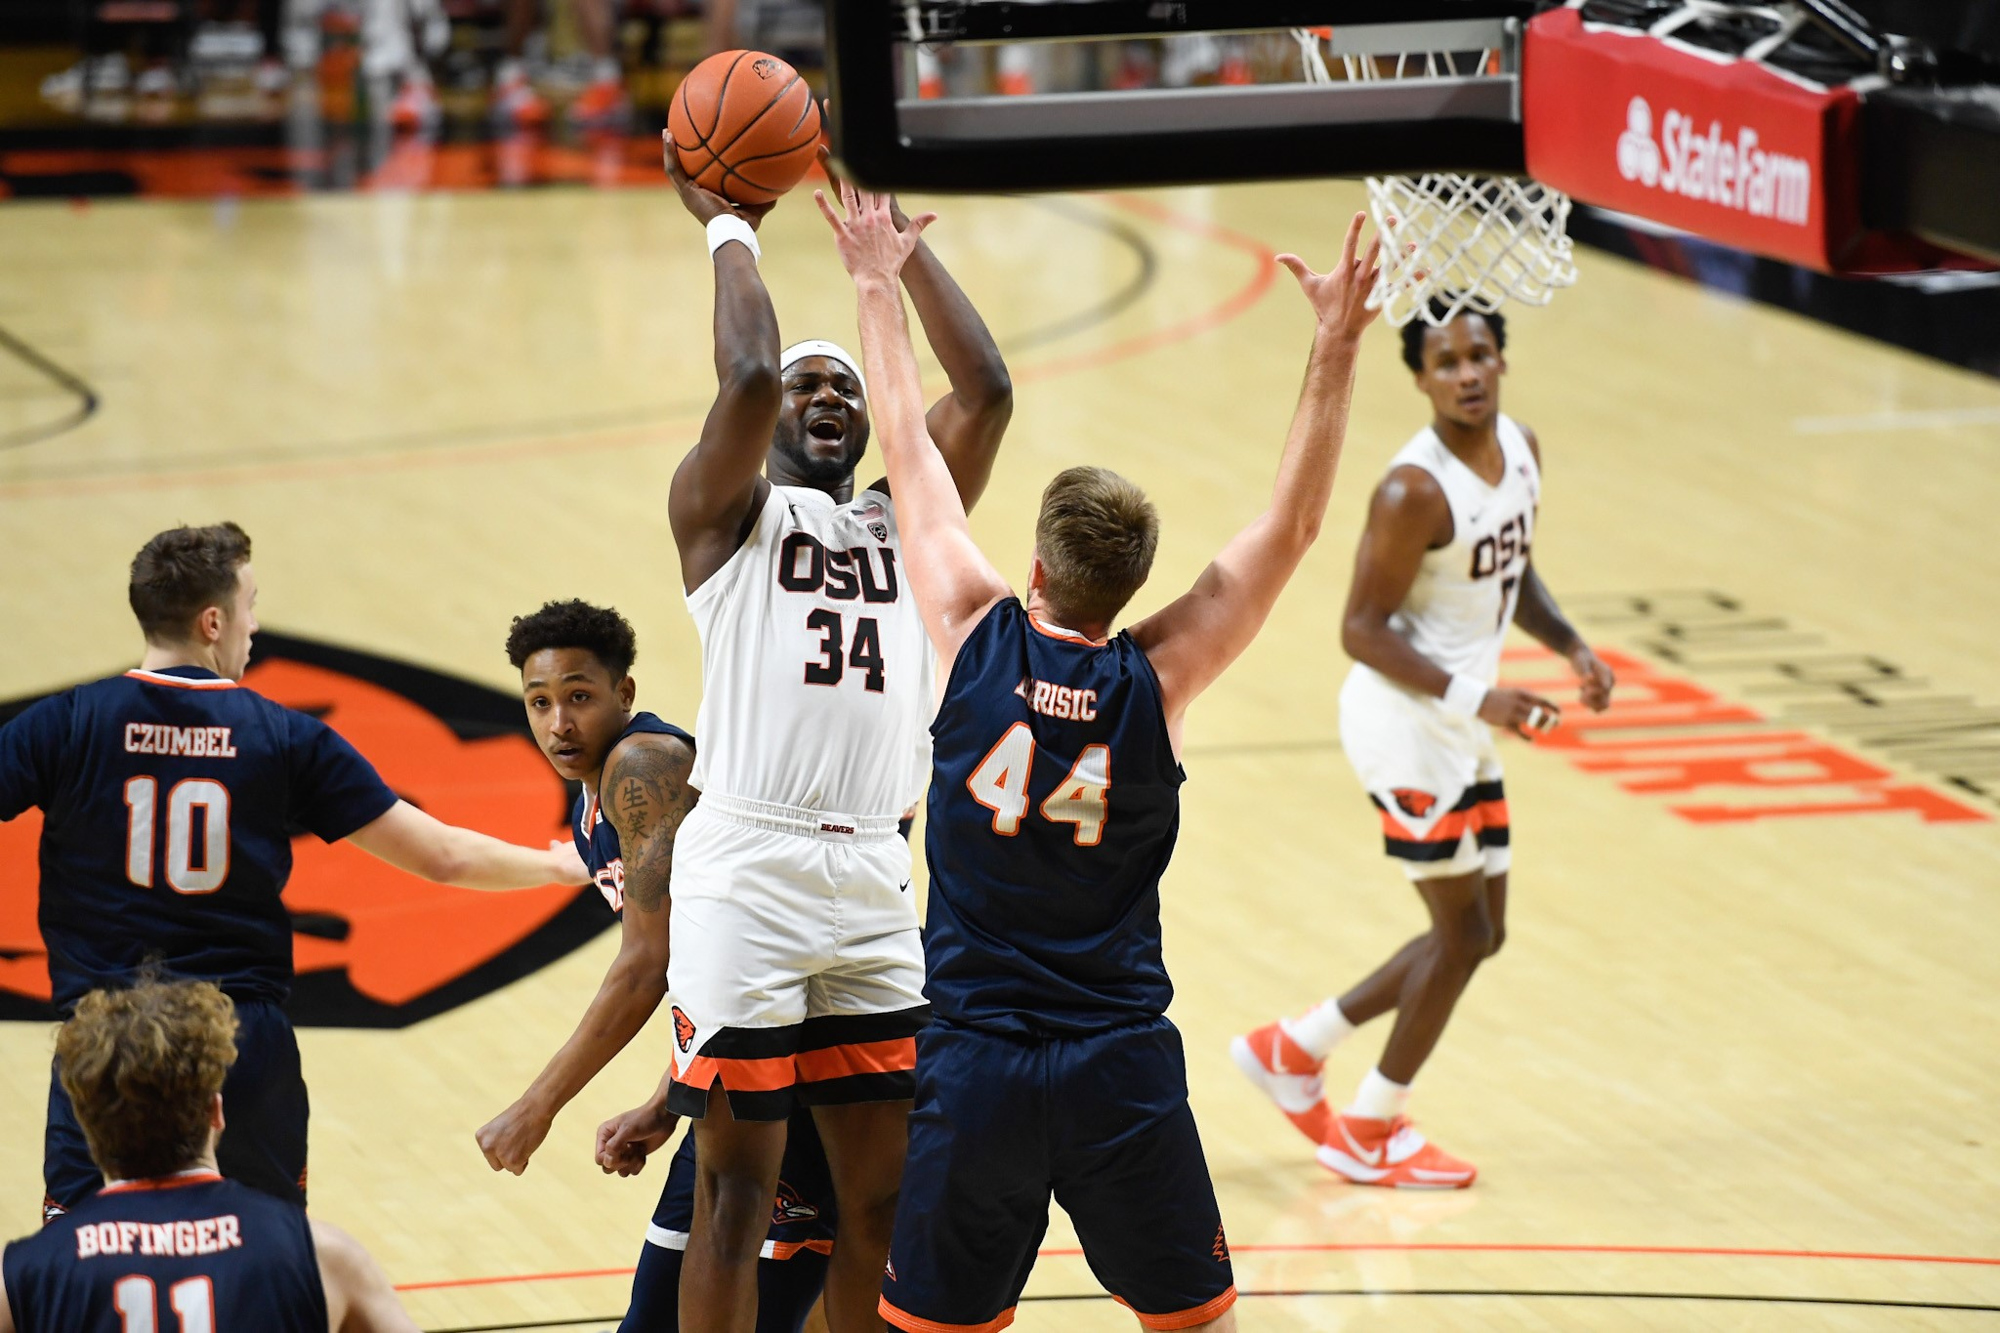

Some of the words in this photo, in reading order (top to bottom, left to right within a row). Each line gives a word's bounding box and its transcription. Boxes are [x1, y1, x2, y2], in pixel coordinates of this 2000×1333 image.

[778, 531, 899, 604] OSU
[803, 607, 885, 693] 34
[1013, 676, 1098, 722] RISIC
[124, 722, 237, 758] CZUMBEL
[966, 721, 1112, 847] 44
[123, 774, 231, 895] 10
[820, 823, 855, 835] BEAVERS
[75, 1214, 243, 1260] BOFINGER
